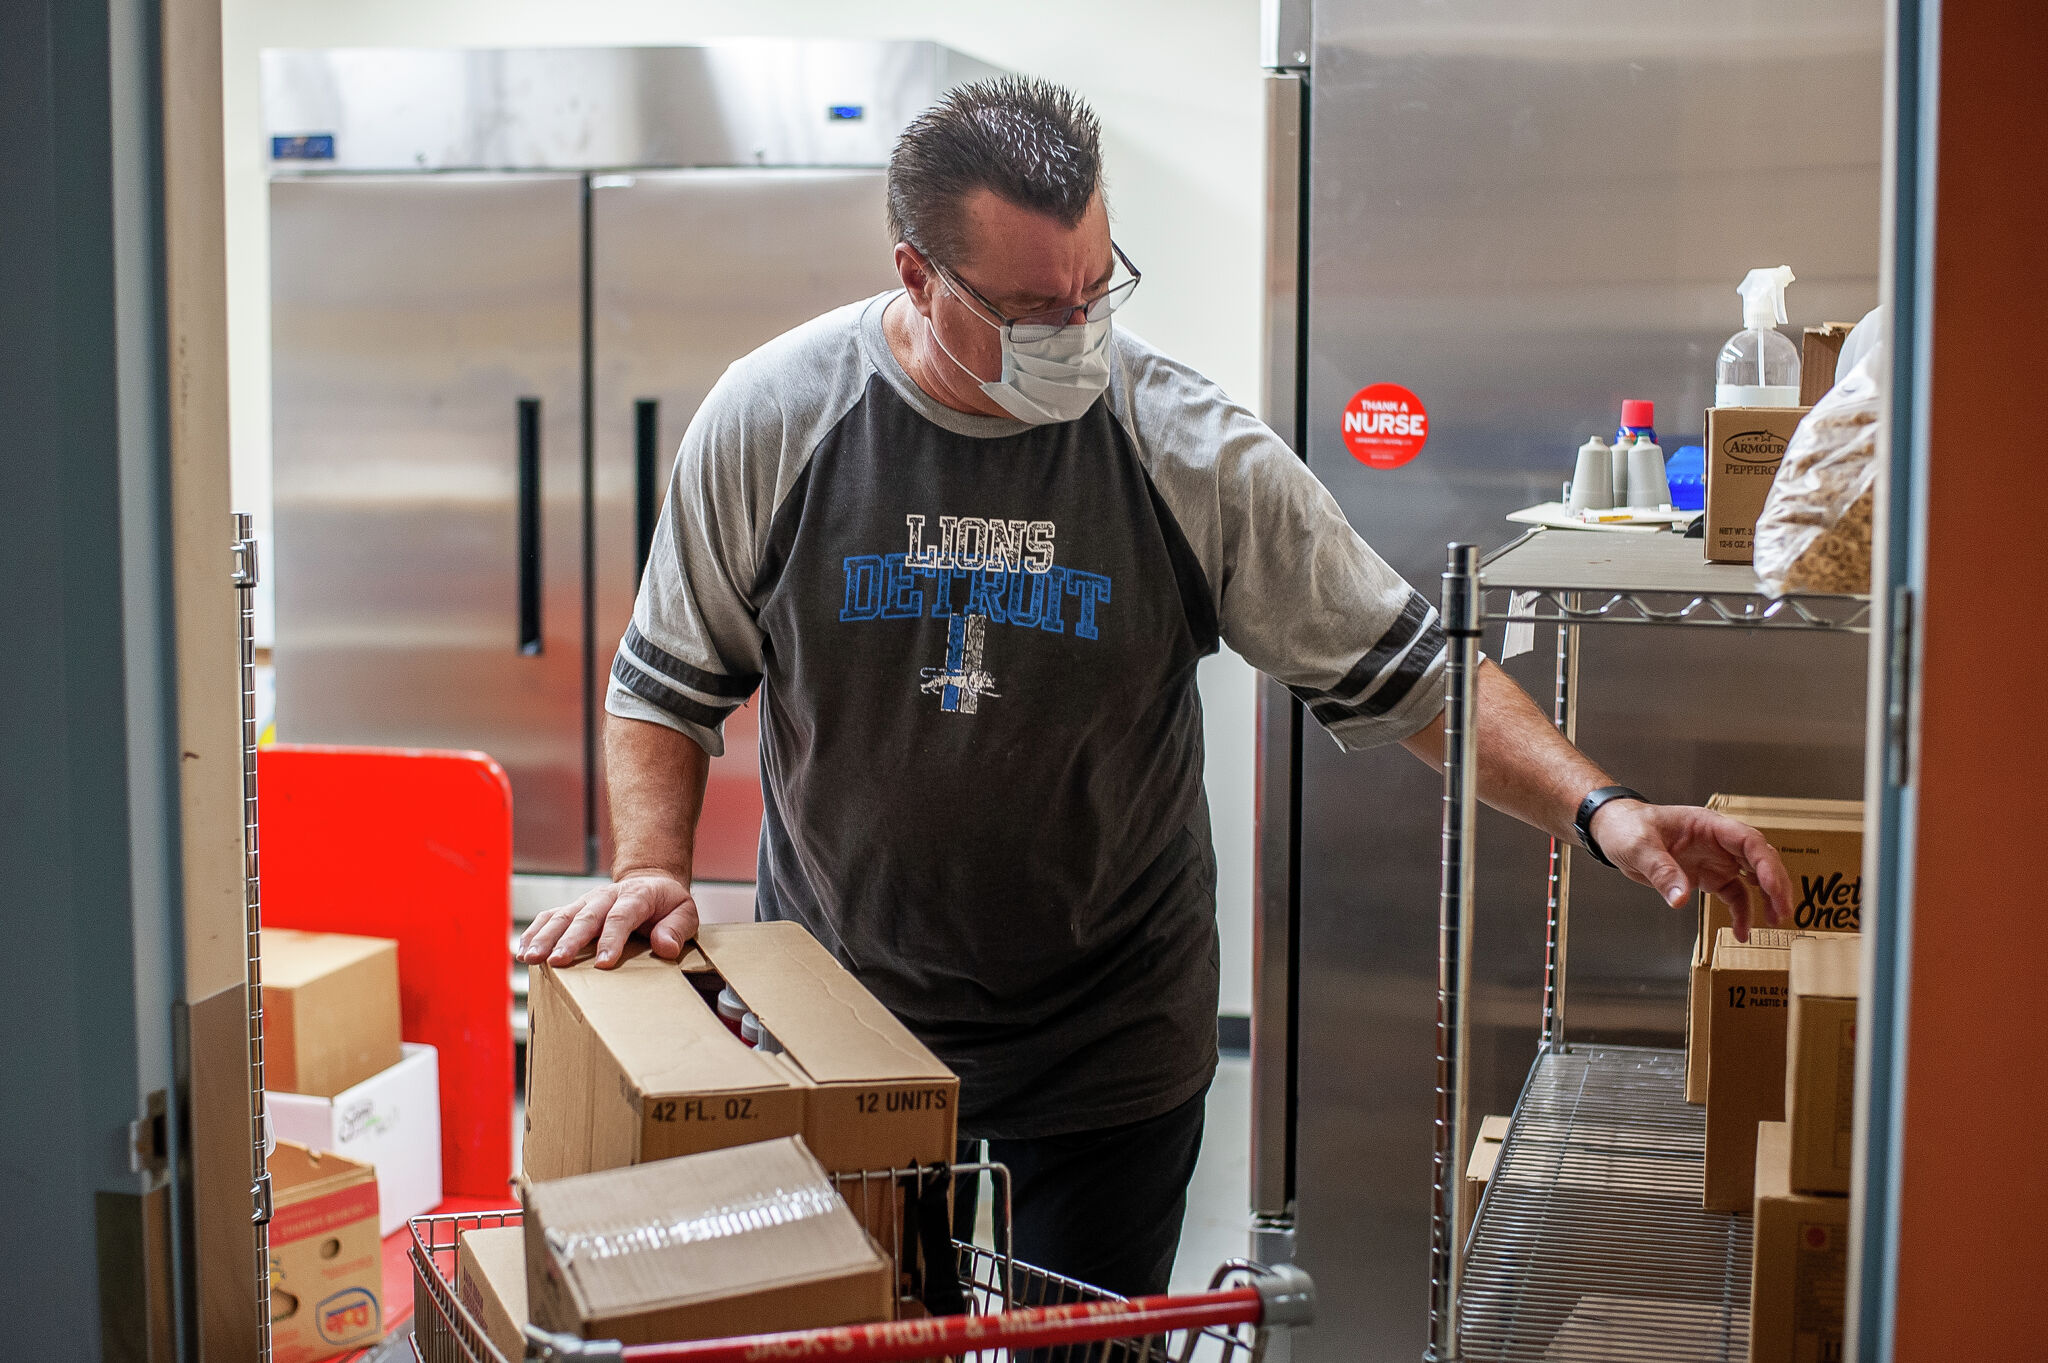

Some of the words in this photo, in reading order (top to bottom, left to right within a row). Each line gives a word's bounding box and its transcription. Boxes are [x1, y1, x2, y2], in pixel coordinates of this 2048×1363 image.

[1361, 400, 1398, 412] THANK
[1400, 401, 1408, 412] A
[1344, 412, 1425, 436] NURSE
[1728, 441, 1785, 455] ARMOUR
[1719, 527, 1734, 536] NET
[905, 514, 1055, 574] LIONS
[839, 552, 1111, 640] DETROIT
[1801, 872, 1862, 906] Wet
[1728, 985, 1746, 1009] 12
[1749, 998, 1781, 1008] PLASTIC
[1760, 986, 1768, 995] FL
[1769, 986, 1779, 996] OZ
[651, 1101, 677, 1122] 42
[684, 1099, 716, 1122] FL.
[724, 1098, 759, 1120] OZ.
[856, 1092, 879, 1114] 12
[885, 1088, 948, 1112] UNITS
[864, 1315, 948, 1348] FRUIT
[964, 1312, 986, 1338] &
[998, 1303, 1074, 1334] MEAT
